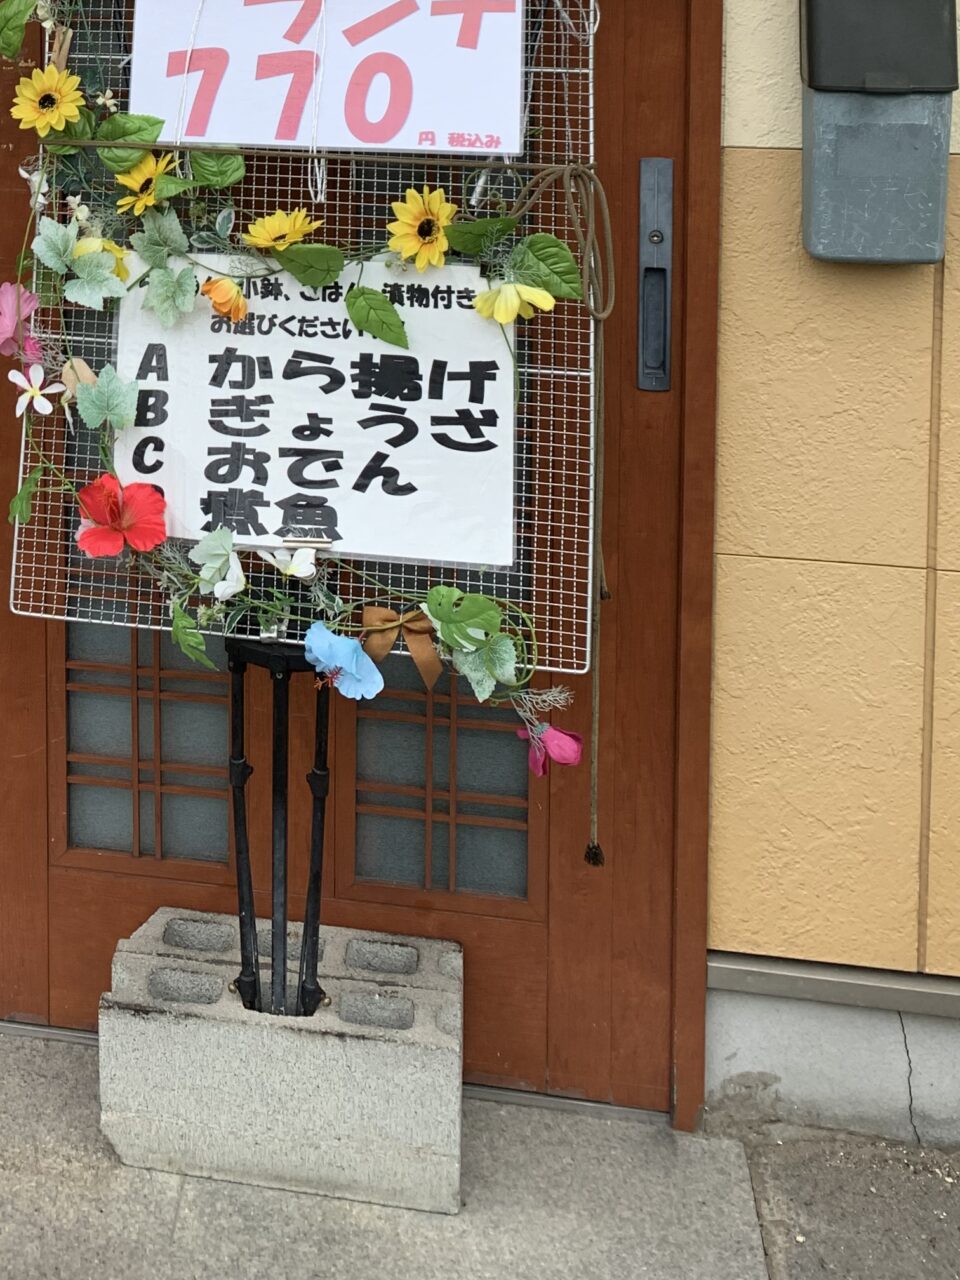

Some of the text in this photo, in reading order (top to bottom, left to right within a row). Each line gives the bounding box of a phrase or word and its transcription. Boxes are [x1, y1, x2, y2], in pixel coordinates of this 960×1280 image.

[136, 343, 500, 405] A から揚げ
[134, 389, 499, 452] B ぎょうざ
[132, 435, 418, 496] C おでん
